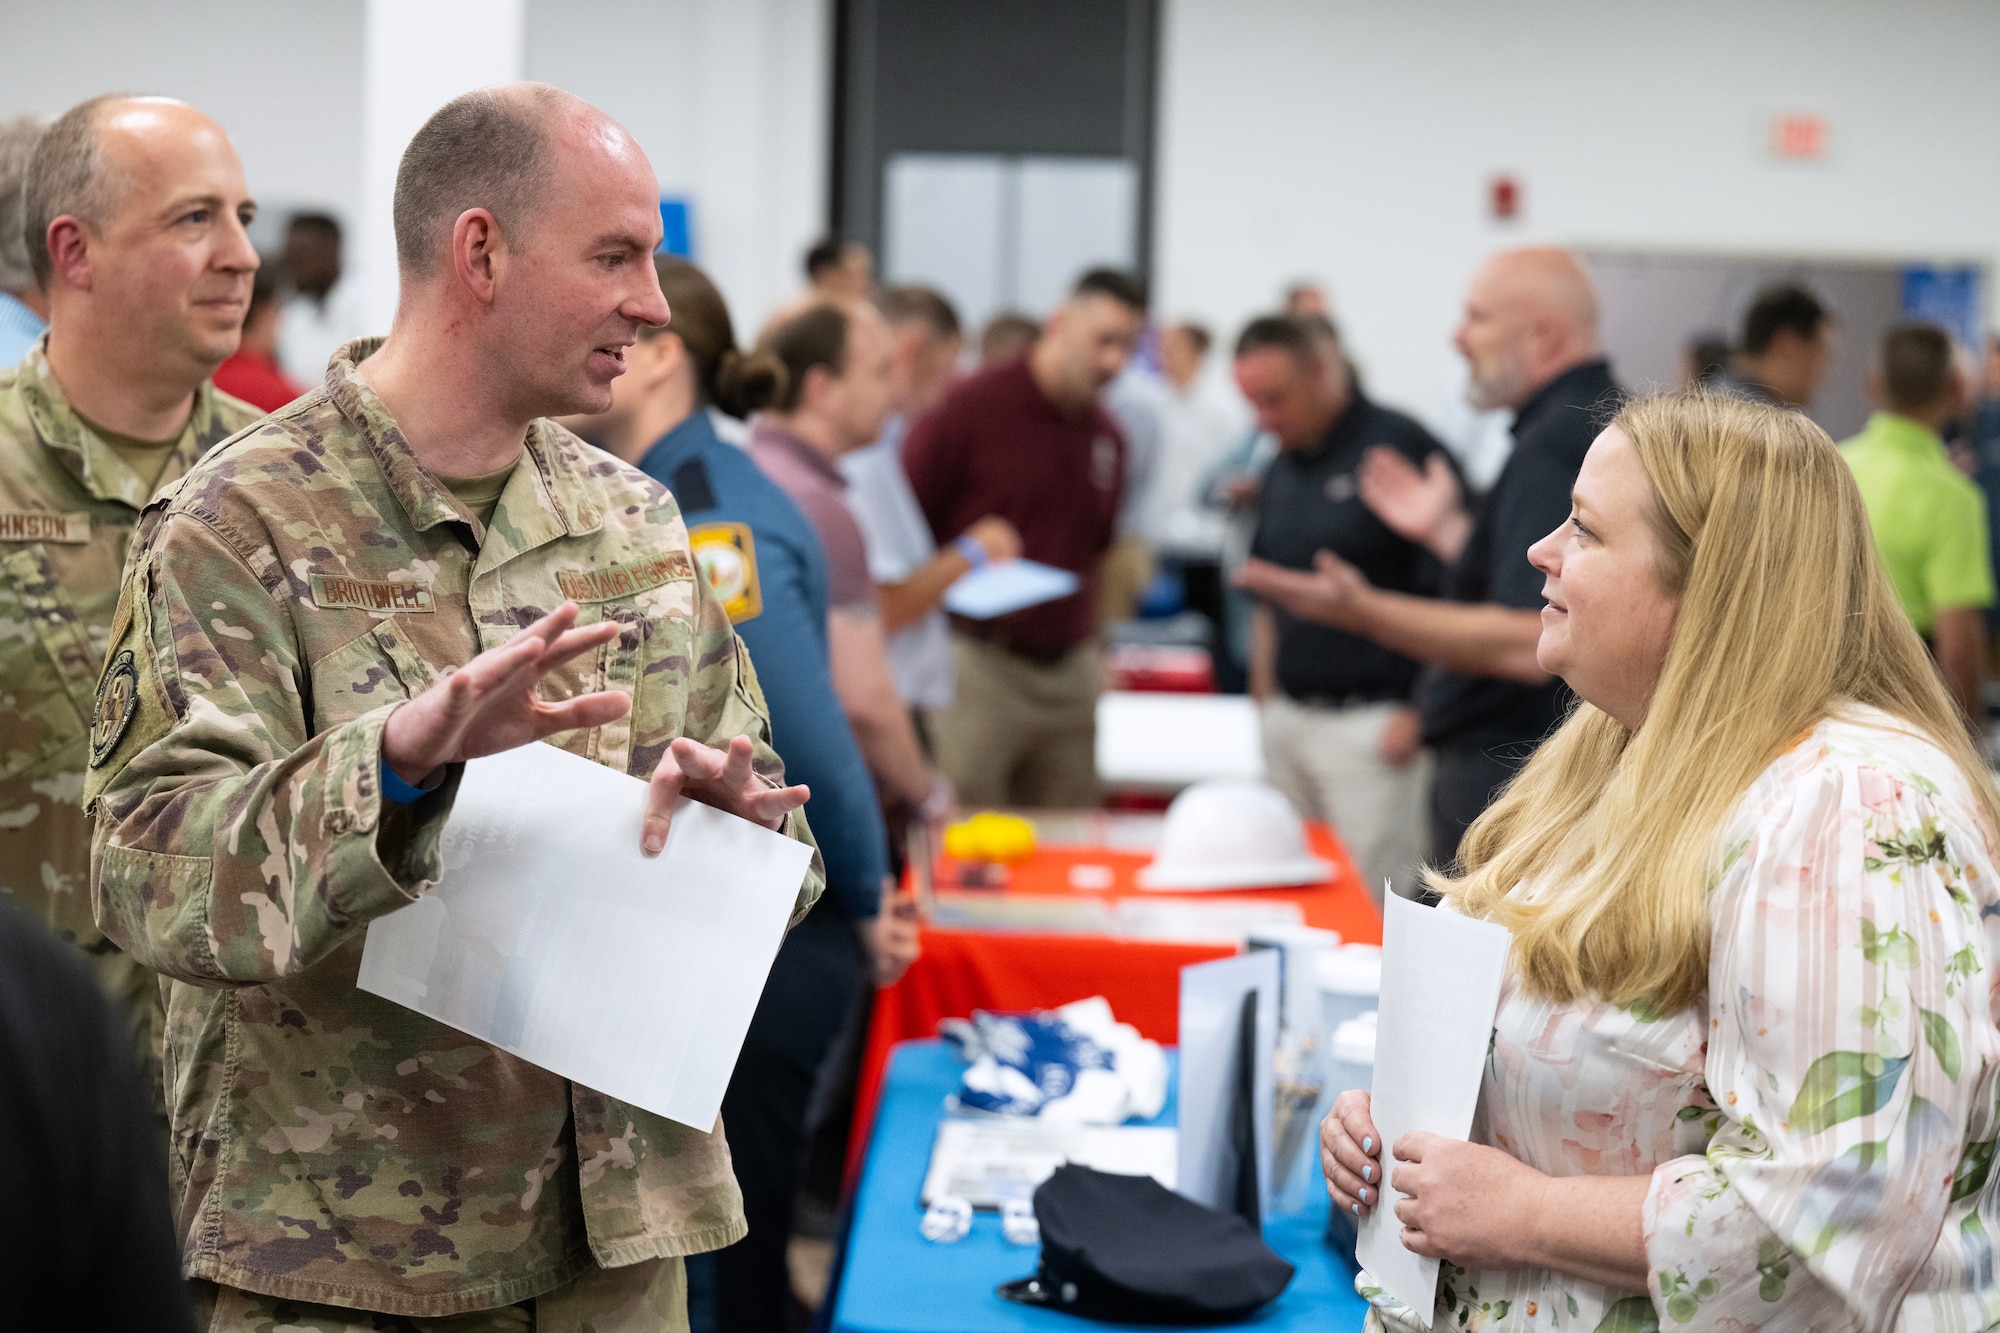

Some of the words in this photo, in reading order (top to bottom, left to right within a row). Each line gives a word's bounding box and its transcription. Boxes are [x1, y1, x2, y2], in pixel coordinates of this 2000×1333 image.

[323, 578, 425, 609] BROTHWELL
[600, 571, 634, 599] AIR
[631, 555, 692, 589] FORCE
